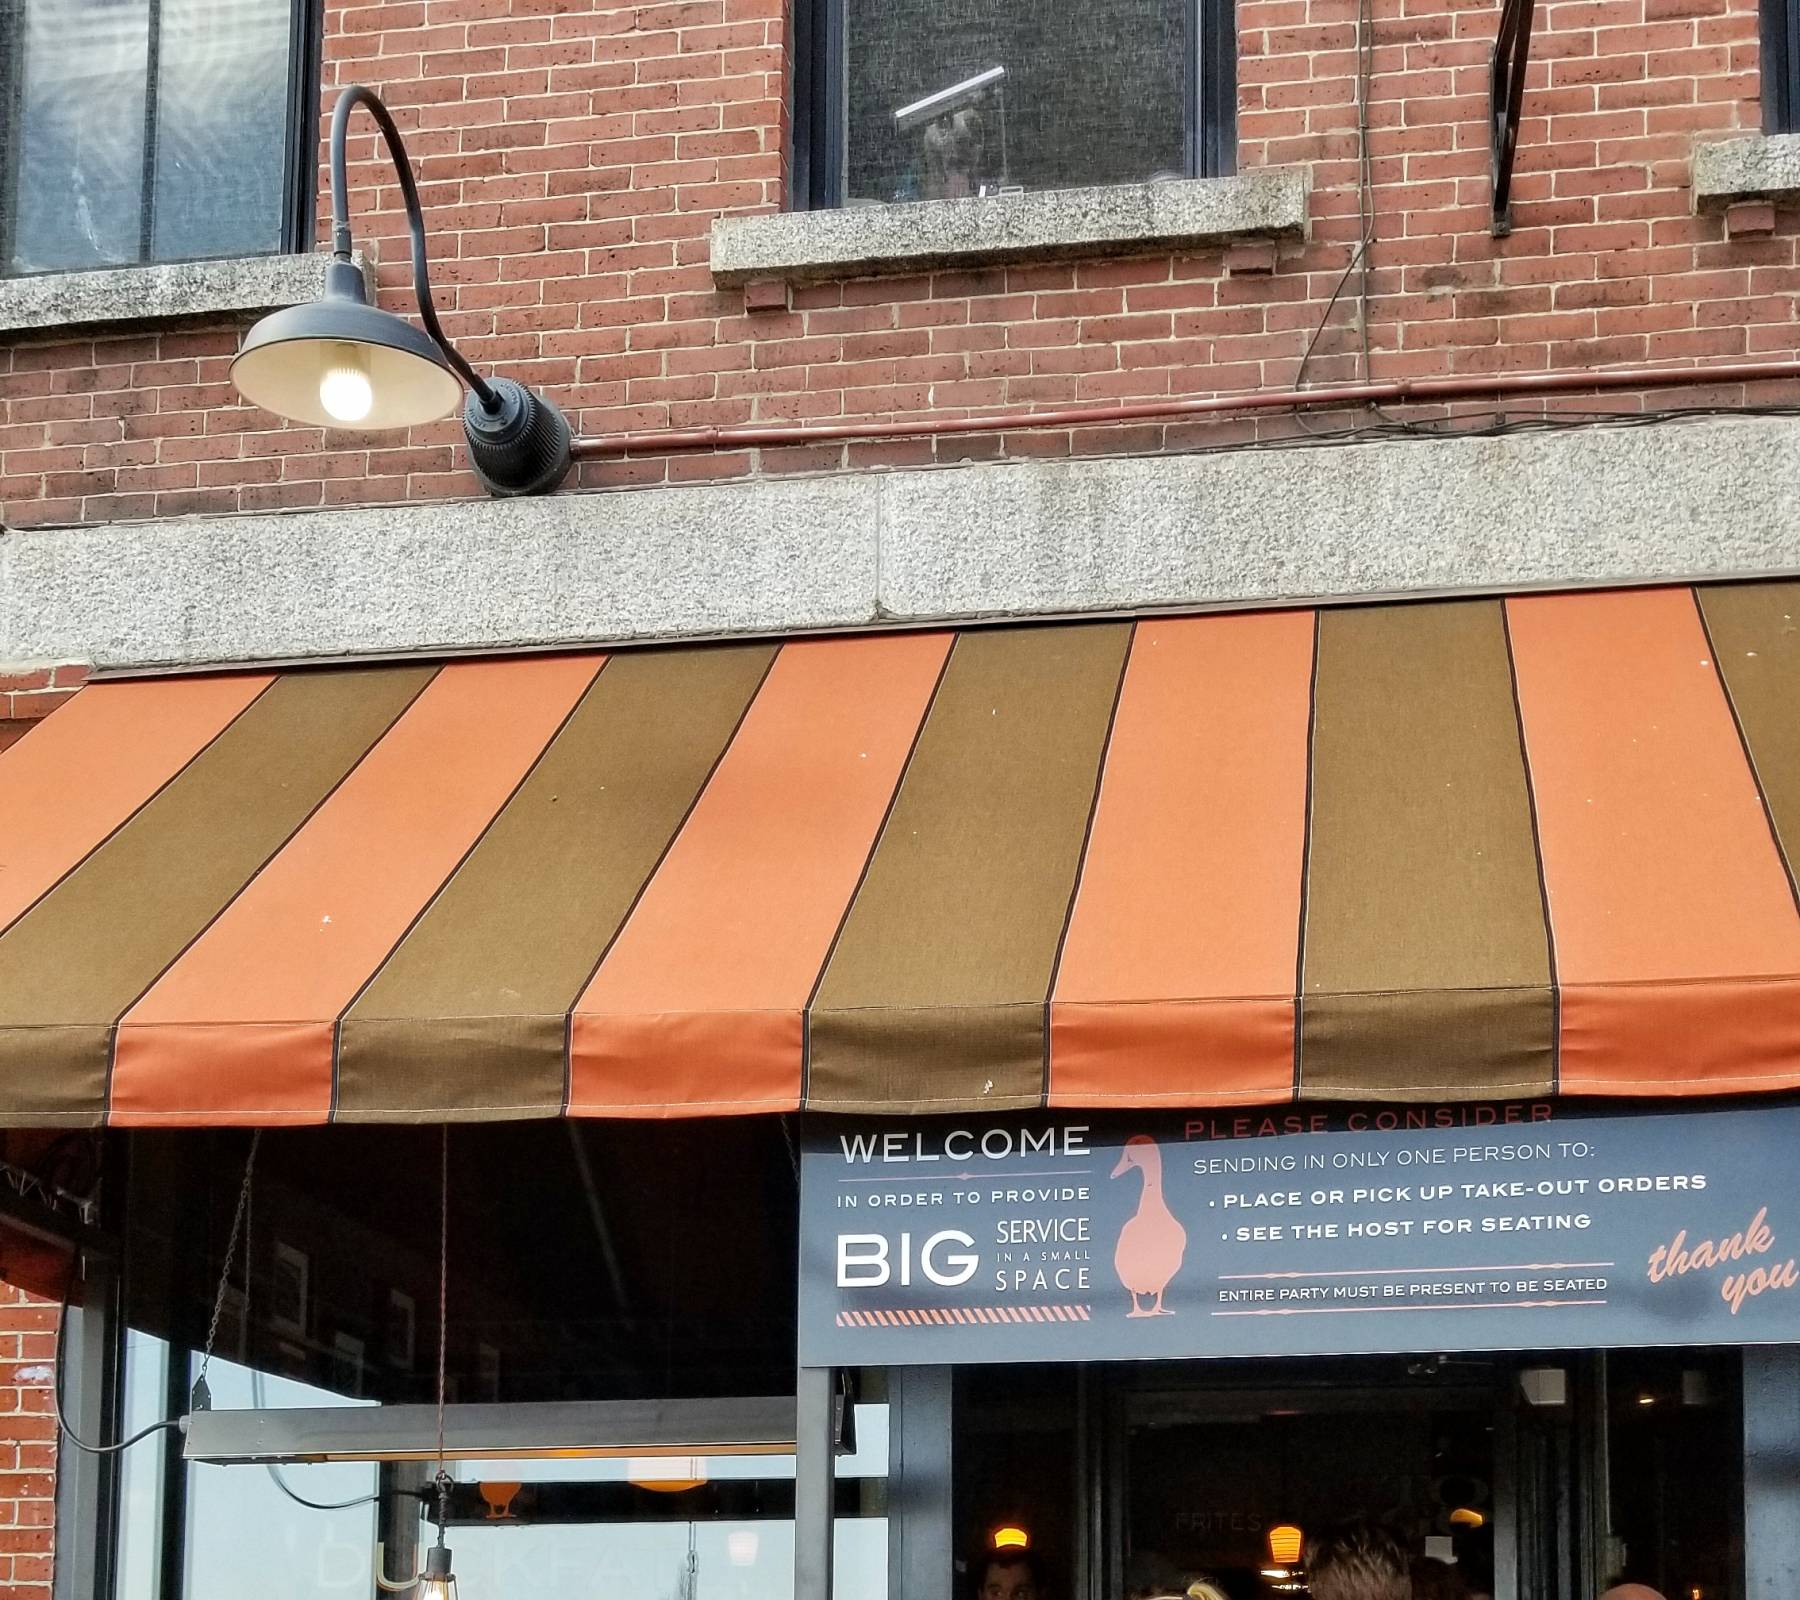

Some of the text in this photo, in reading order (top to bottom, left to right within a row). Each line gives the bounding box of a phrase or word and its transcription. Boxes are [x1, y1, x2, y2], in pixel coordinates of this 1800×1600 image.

[1184, 1104, 1553, 1139] PLEASE CONSIDER
[840, 1126, 1091, 1164] WELCOME
[1193, 1142, 1596, 1175] SENDING IN ONLY ONE PERSON TO:
[837, 1187, 1090, 1208] IN ORDER TO PROVIDE
[1223, 1175, 1707, 1209] PLACE OR PICK UP TAKE-OUT ORDERS
[996, 1217, 1091, 1244] SERVICE
[1236, 1214, 1592, 1241] SEE THE HOST FOR SEATING
[836, 1229, 979, 1288] BIG
[997, 1249, 1090, 1263] IN A SMALL
[1648, 1206, 1775, 1283] thank
[995, 1267, 1090, 1291] SPACE
[1218, 1277, 1607, 1302] ENTIRE PARTY MUST BE PRESENT TO BE SEATED
[1721, 1259, 1798, 1315] you
[1175, 1511, 1263, 1532] FRITES
